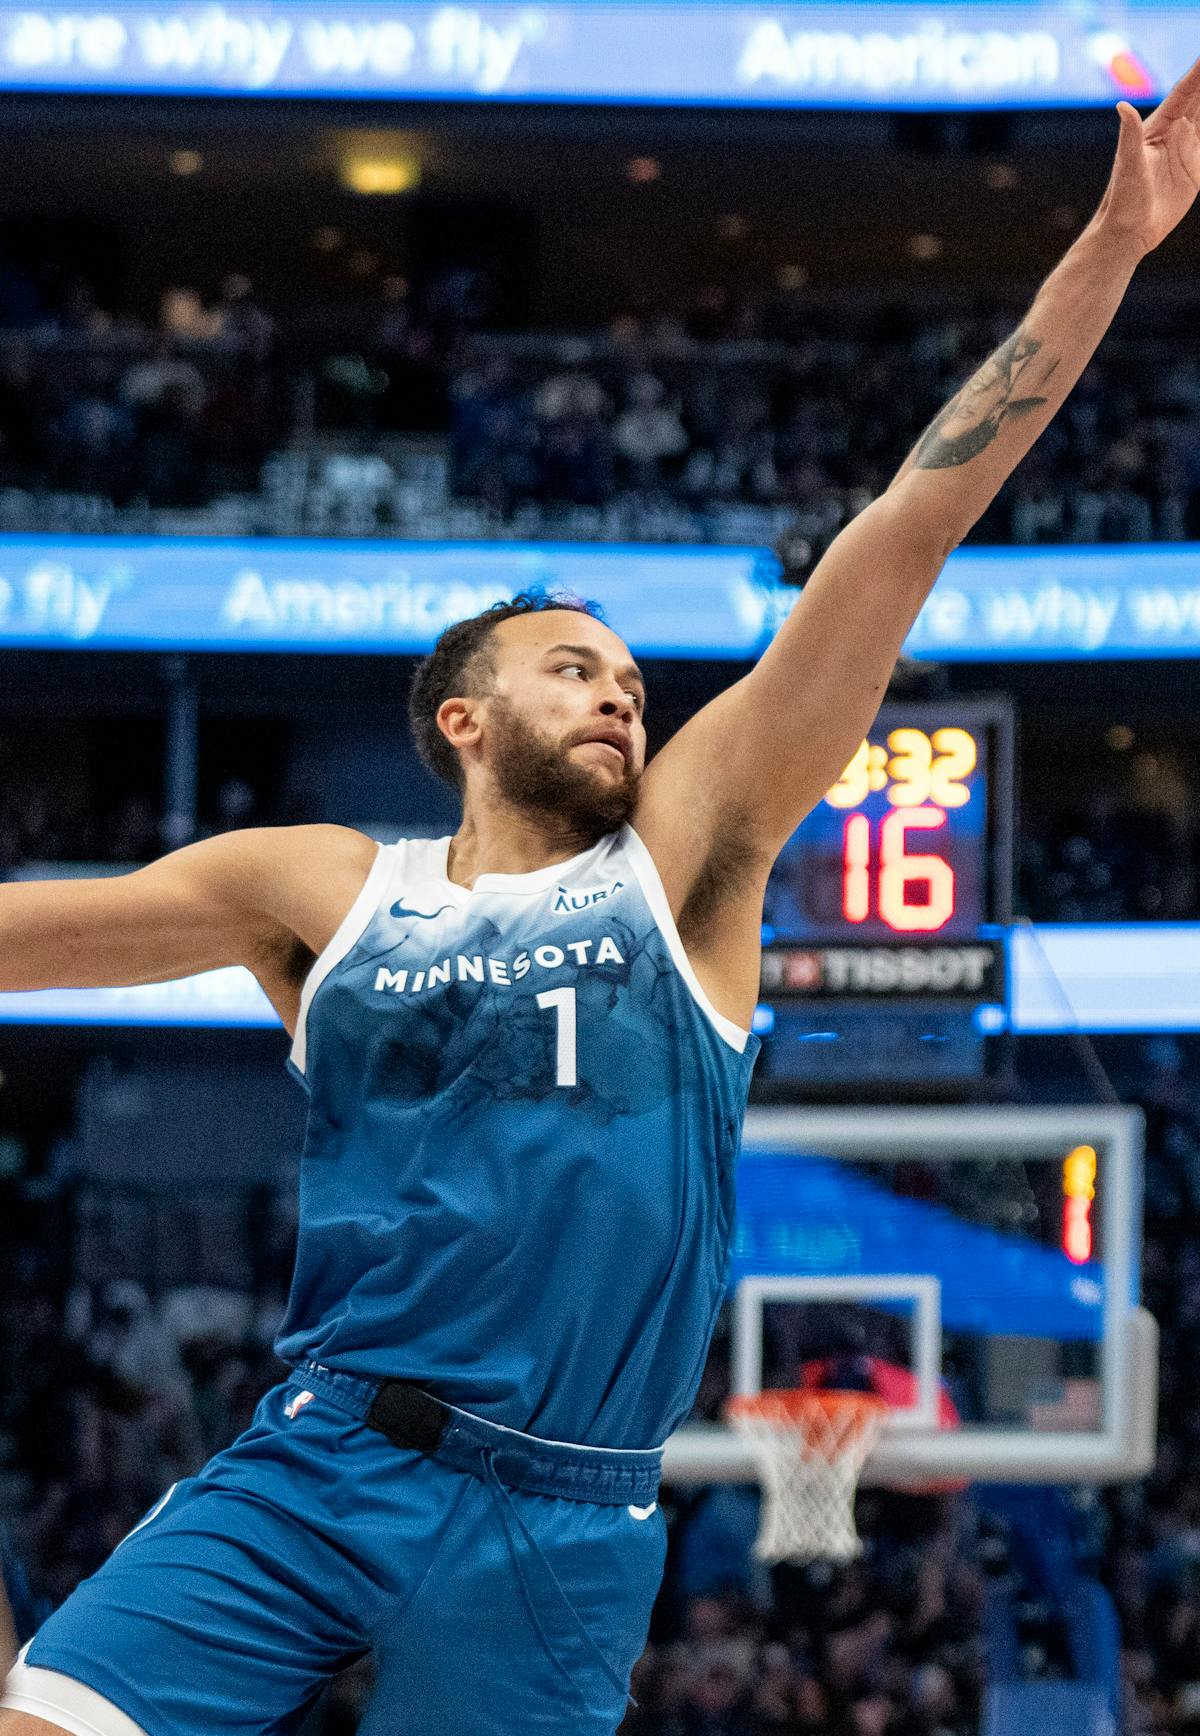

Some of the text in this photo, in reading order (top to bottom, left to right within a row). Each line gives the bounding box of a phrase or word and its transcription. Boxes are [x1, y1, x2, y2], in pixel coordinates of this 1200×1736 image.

[5, 8, 525, 94] are why we fly
[736, 19, 1060, 88] American
[26, 560, 113, 639] fly
[984, 576, 1118, 651] why
[843, 806, 955, 931] 16
[374, 936, 625, 993] MINNESOTA
[824, 948, 994, 990] TISSOT
[536, 986, 577, 1087] 1
